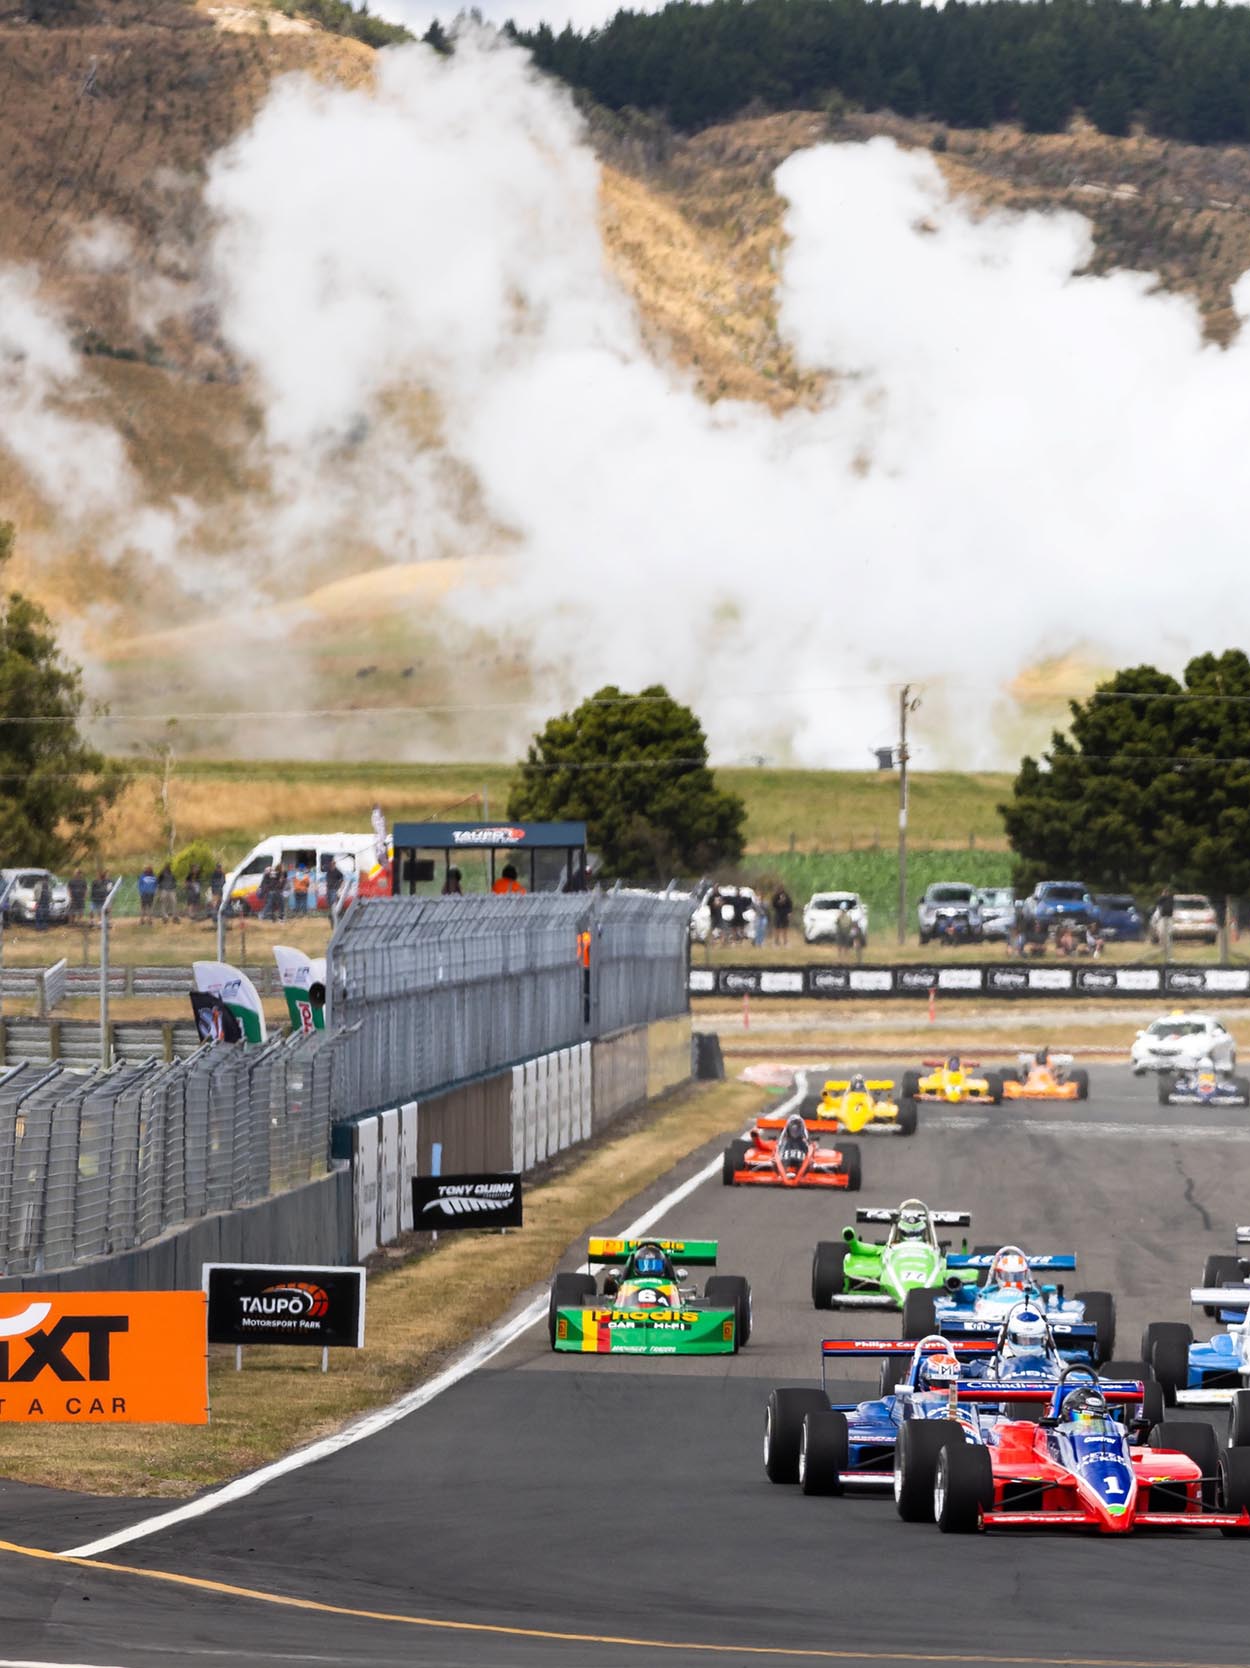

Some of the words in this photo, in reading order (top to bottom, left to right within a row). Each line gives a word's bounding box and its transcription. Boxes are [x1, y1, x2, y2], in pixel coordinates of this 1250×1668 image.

[438, 1185, 474, 1196] TONY
[474, 1183, 514, 1194] QUINN
[240, 1296, 303, 1314] TAUPŌ
[854, 1341, 892, 1349] Philips
[28, 1398, 44, 1415] A
[66, 1398, 127, 1415] CAR
[1103, 1476, 1125, 1494] 1
